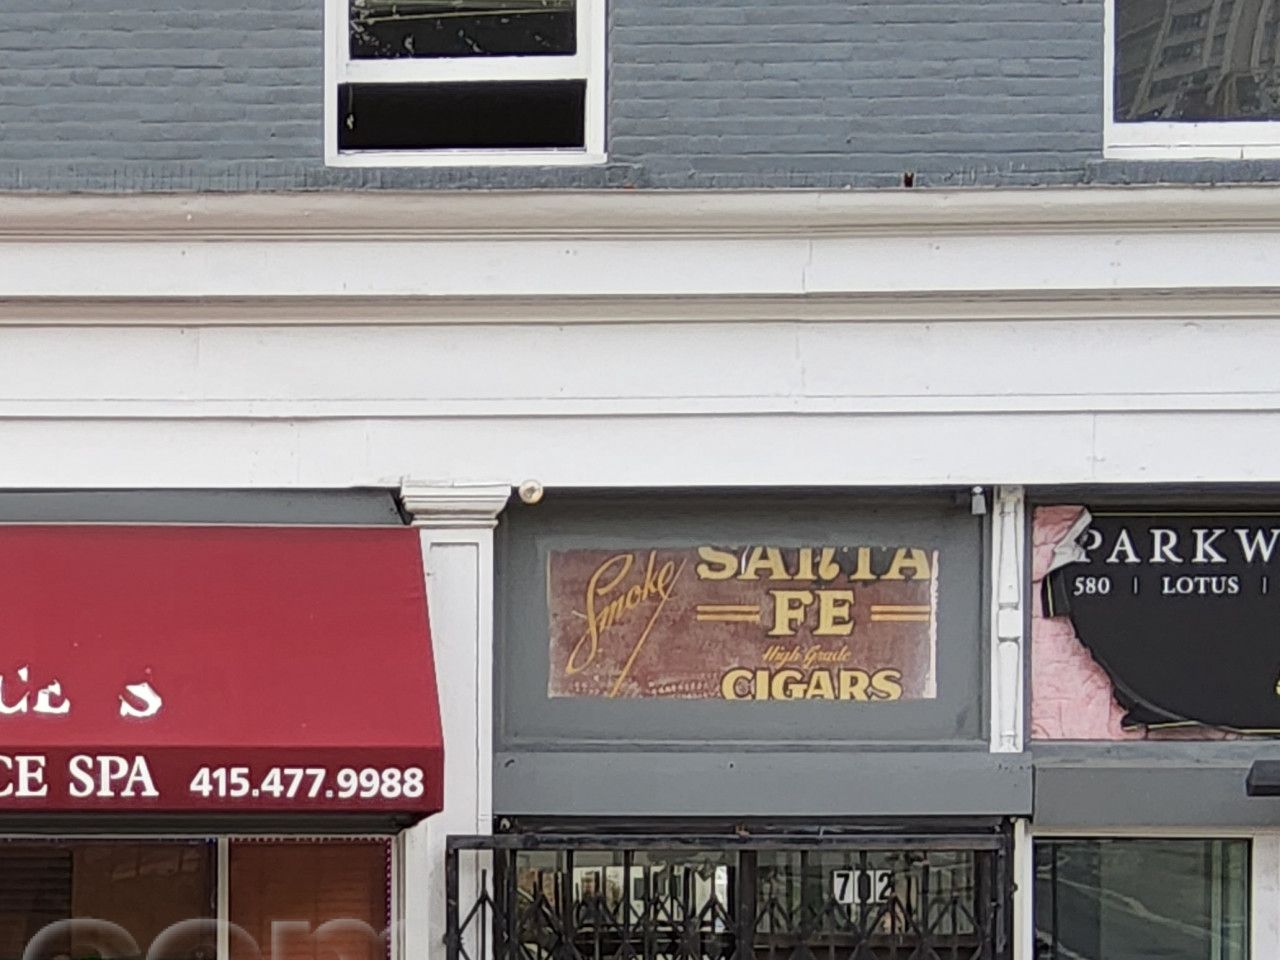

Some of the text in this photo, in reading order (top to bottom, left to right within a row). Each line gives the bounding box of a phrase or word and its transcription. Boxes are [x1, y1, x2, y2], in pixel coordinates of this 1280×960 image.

[1074, 577, 1240, 595] 580 LOTUS
[566, 550, 686, 697] Smoke
[768, 590, 854, 636] FE
[721, 668, 903, 700] CIGARS
[69, 754, 160, 797] SPA
[189, 767, 424, 798] 415.477.9988
[835, 873, 895, 901] 702
